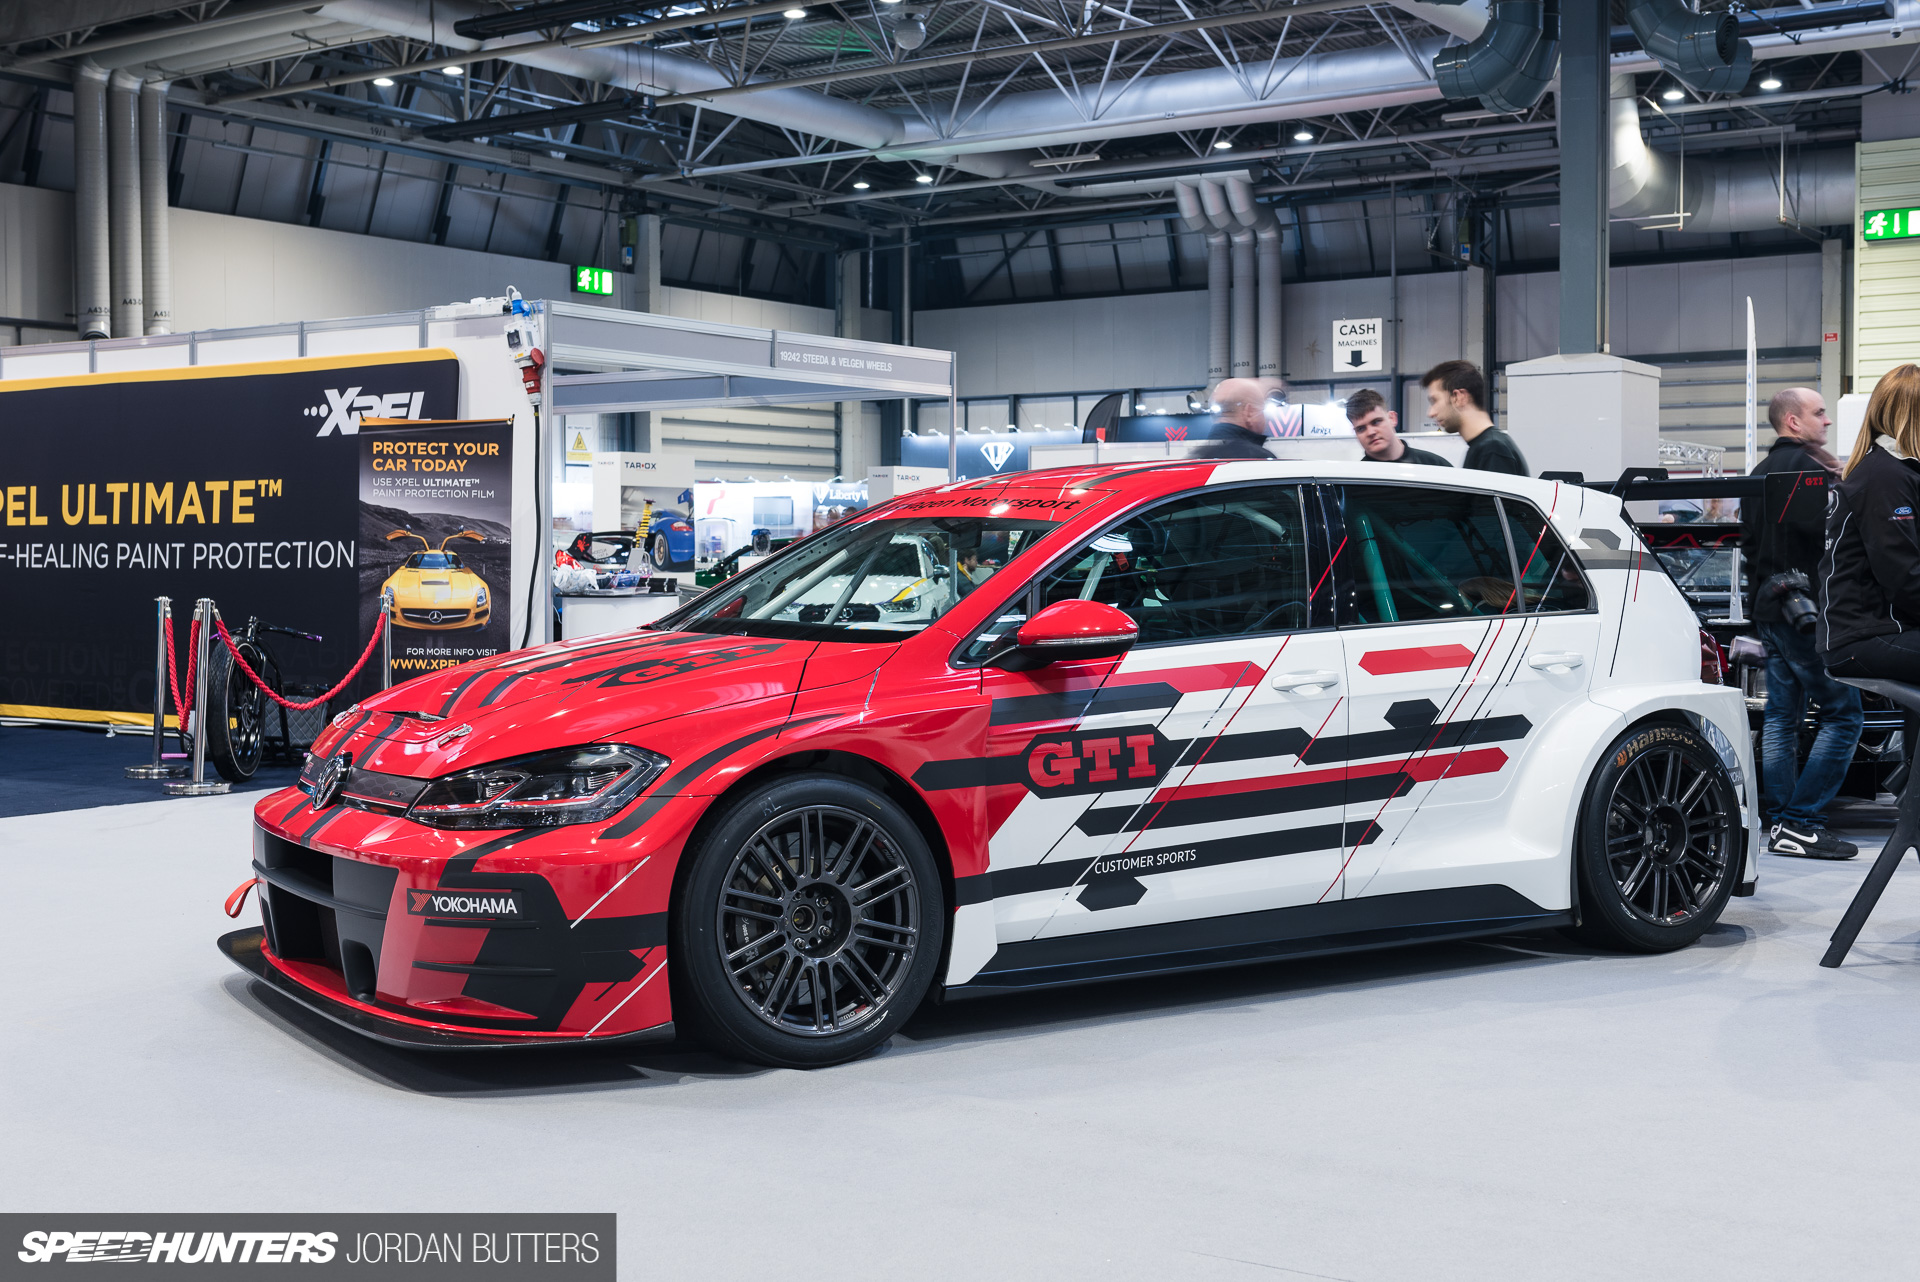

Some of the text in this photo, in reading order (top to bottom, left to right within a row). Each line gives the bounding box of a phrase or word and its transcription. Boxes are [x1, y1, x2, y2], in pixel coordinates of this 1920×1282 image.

[1339, 323, 1376, 336] CASH
[1338, 338, 1378, 348] MACHINES
[780, 351, 892, 372] 19242 STEEDA & VELGEN WHEELS
[372, 441, 500, 456] PROTECT YOUR
[372, 458, 468, 473] CAR TODAY
[372, 477, 393, 487] USE
[394, 477, 421, 487] XPEL
[1805, 476, 1824, 487] GTI
[372, 488, 495, 499] PAINT PROTECTION FILM
[0, 485, 49, 527] EL
[952, 496, 1081, 510] Motorsport
[116, 542, 186, 570] PAINT
[193, 540, 355, 570] PROTECTION
[406, 647, 498, 656] FOR MORE INFO VISIT
[1028, 733, 1157, 788] GTI
[1094, 849, 1197, 874] CUSTOMER SPORTS
[432, 895, 518, 914] YOKOHAMA
